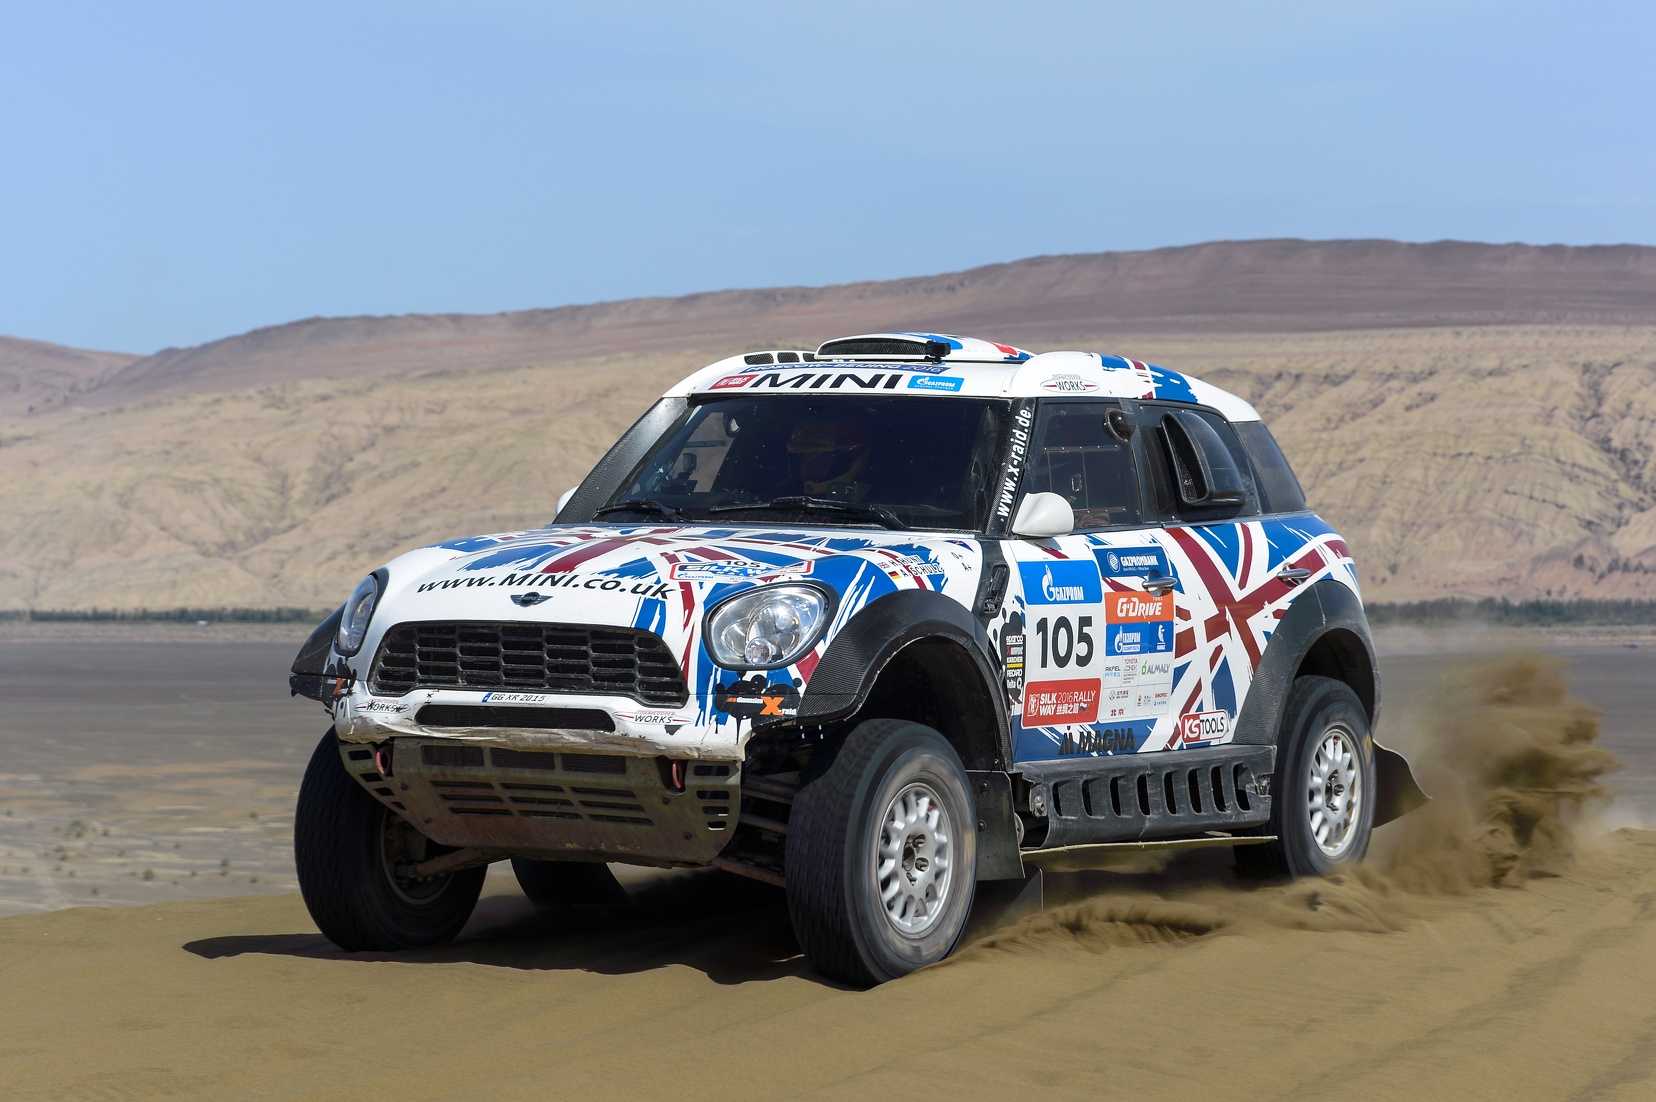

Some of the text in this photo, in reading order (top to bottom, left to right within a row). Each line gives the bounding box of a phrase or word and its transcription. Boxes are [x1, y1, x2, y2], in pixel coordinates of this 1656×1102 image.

[750, 373, 903, 389] MINI
[1056, 381, 1086, 391] WORKS
[997, 409, 1032, 517] www.x-raid.de
[417, 573, 676, 599] www.MINI.co.uk
[1055, 586, 1084, 600] GAZPROM
[1036, 616, 1094, 669] 105
[1040, 690, 1096, 705] SILK 2016 RALLY
[367, 700, 397, 712] WORKS
[1040, 704, 1056, 716] WAY
[634, 714, 673, 724] WORKS
[1185, 717, 1224, 738] KS TOOLS
[1079, 728, 1137, 753] MAGNA
